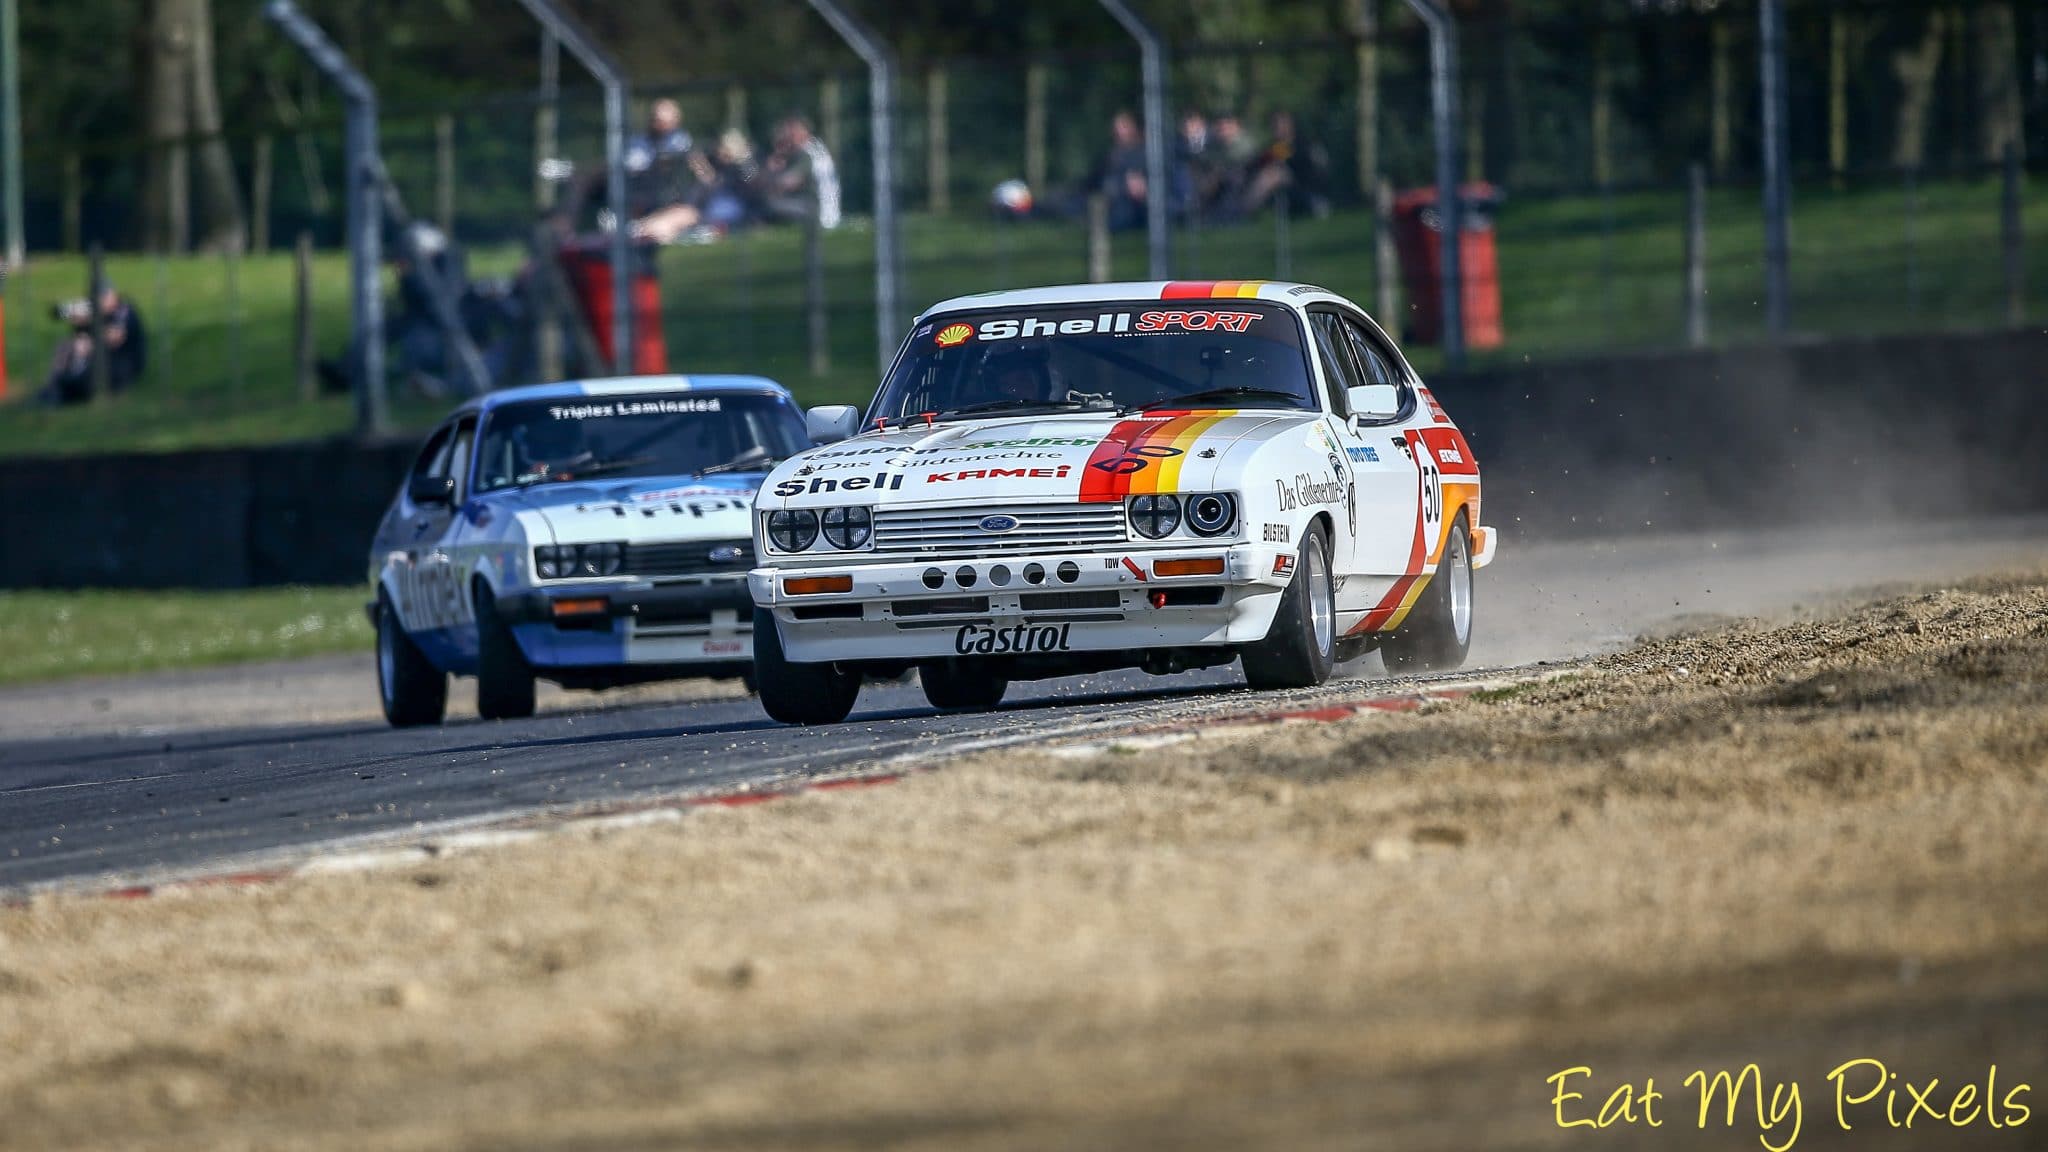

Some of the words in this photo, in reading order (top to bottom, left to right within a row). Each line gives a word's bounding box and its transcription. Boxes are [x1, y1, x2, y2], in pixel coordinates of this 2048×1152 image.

[979, 313, 1131, 342] Shell
[1135, 310, 1264, 332] SPORT
[550, 405, 614, 420] Triplex
[616, 398, 721, 416] Laminated
[816, 460, 872, 470] Das
[885, 451, 1063, 467] Gildenechte
[1092, 445, 1184, 474] 50
[774, 472, 904, 497] Shell
[1276, 478, 1296, 511] Das
[1424, 465, 1440, 524] 50
[1263, 523, 1290, 543] BILSTEIN
[1104, 557, 1119, 569] TOW
[955, 623, 1070, 655] Castrol
